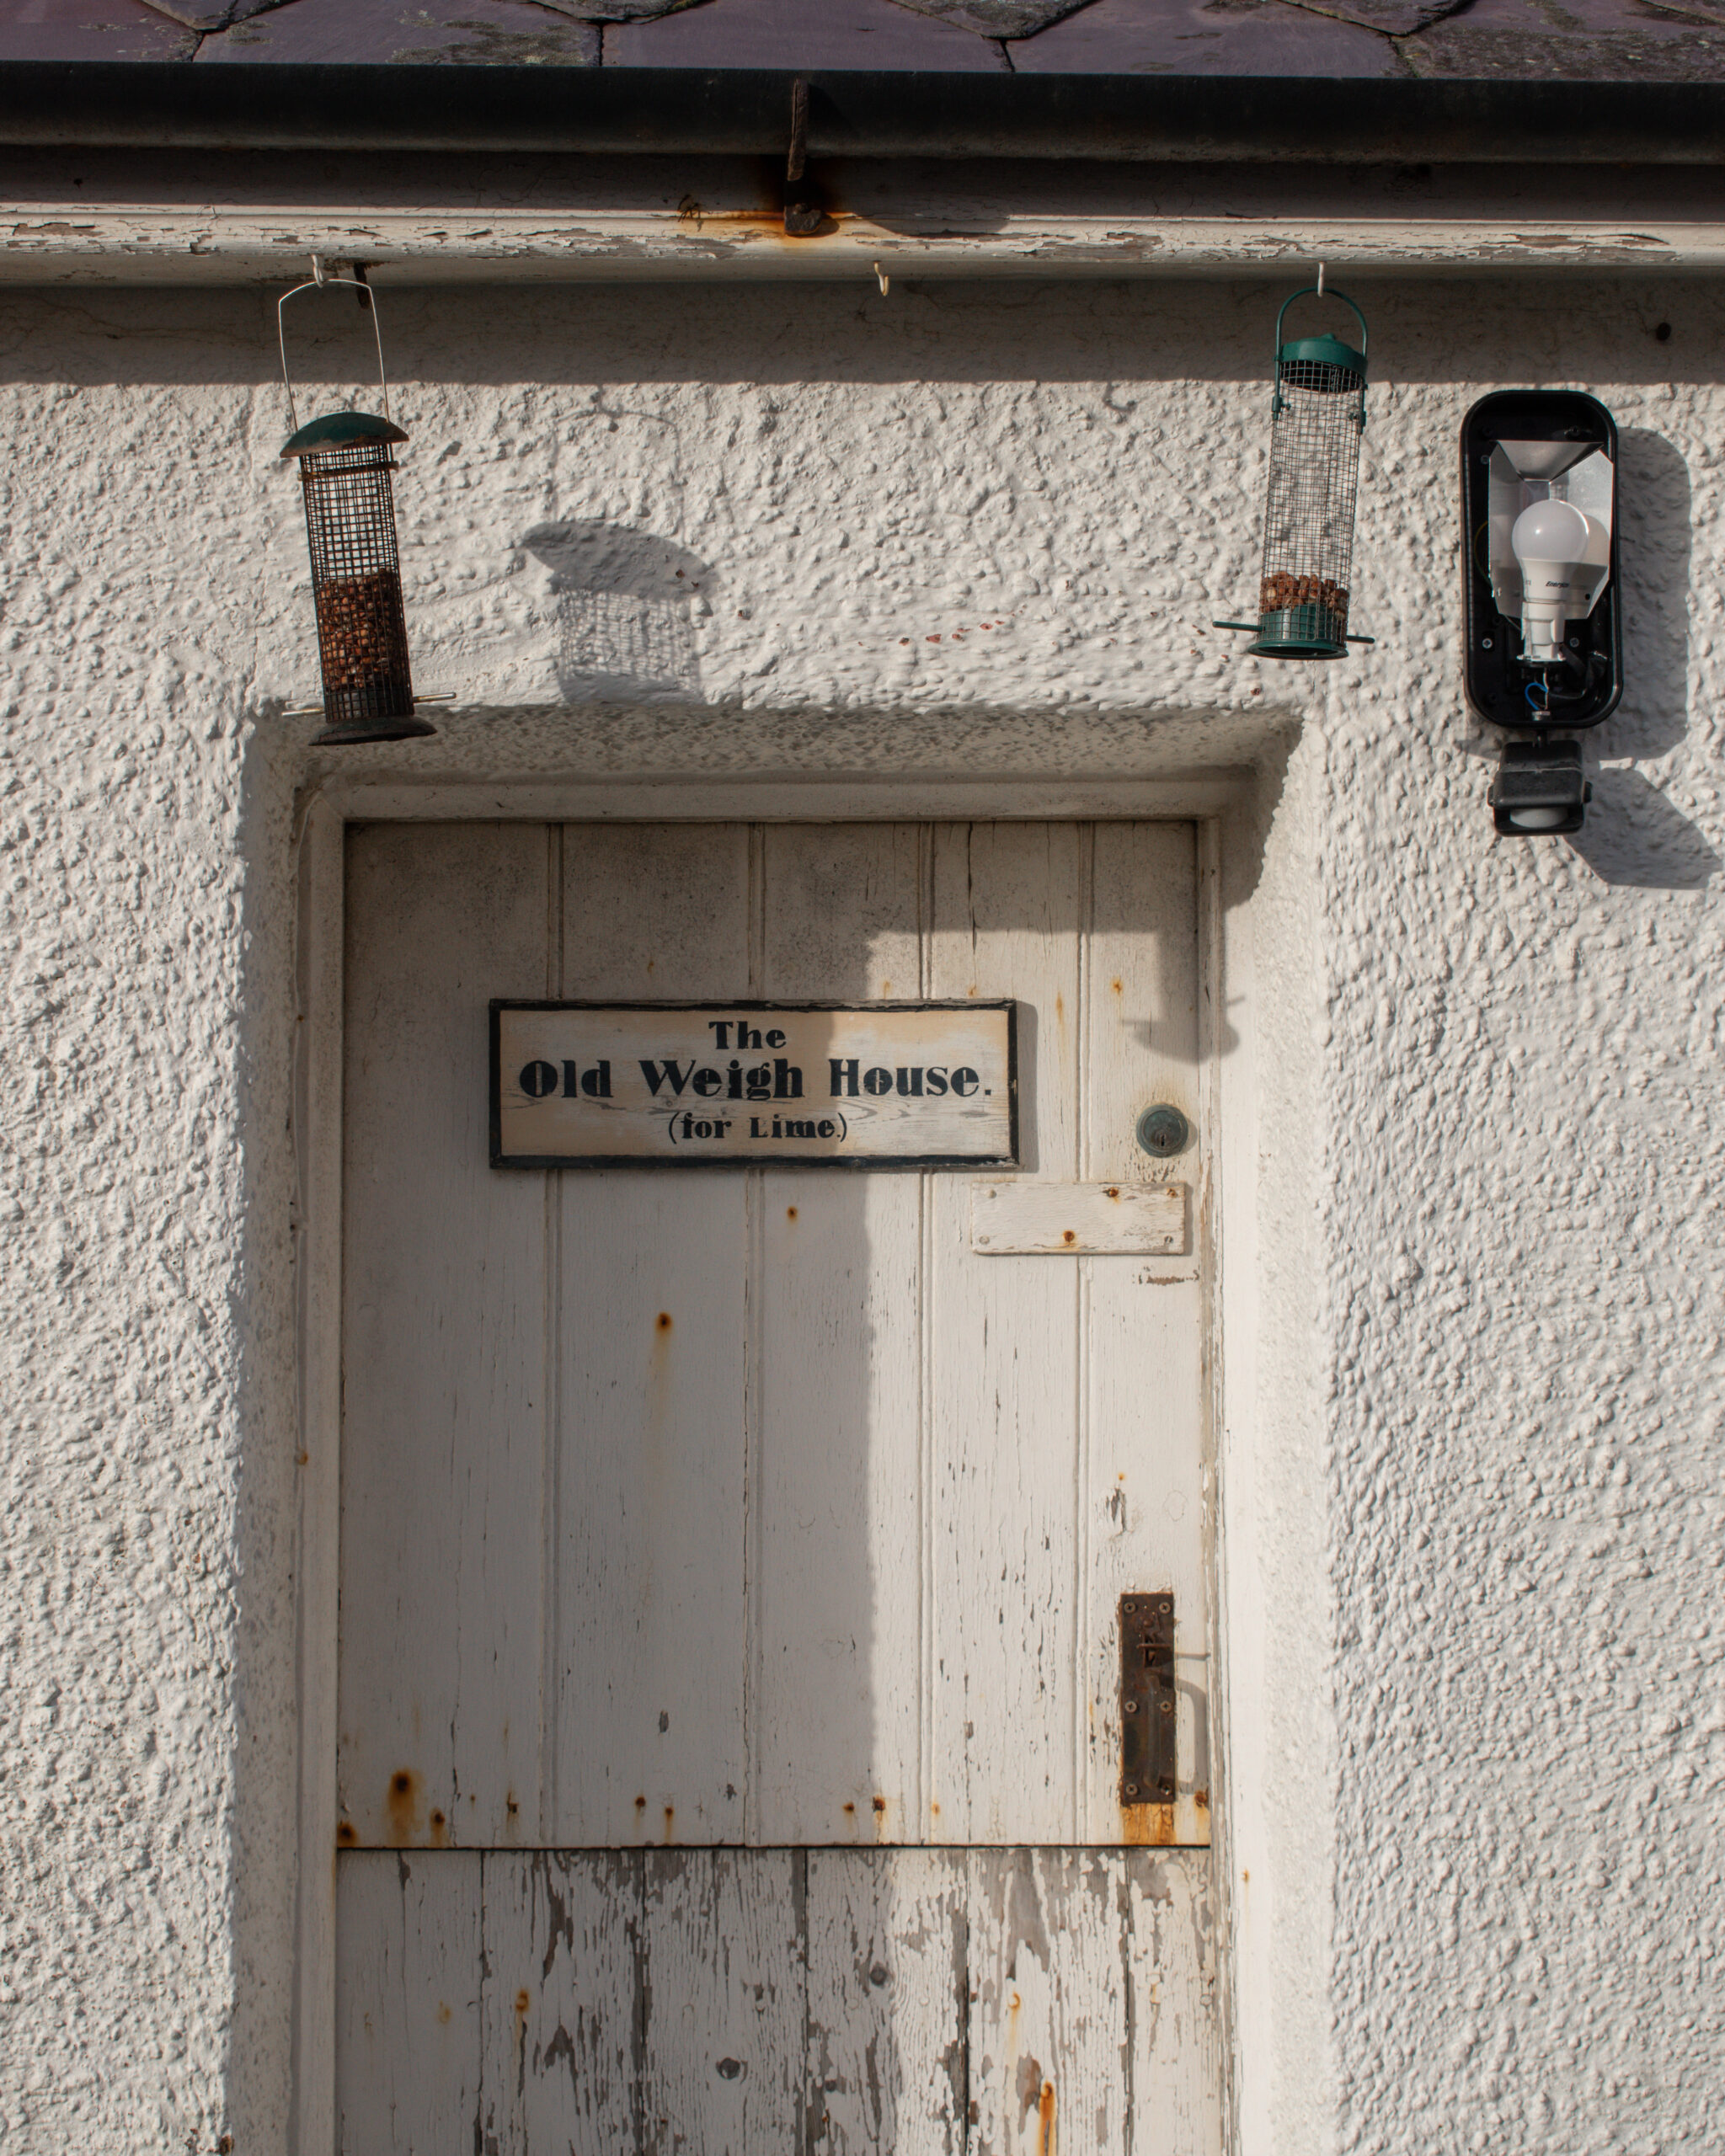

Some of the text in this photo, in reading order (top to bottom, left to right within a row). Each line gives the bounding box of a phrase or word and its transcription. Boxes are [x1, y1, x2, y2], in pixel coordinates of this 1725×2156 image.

[708, 1021, 787, 1050] The
[520, 1059, 993, 1102] Old Weigh House.
[668, 1112, 733, 1145] (for
